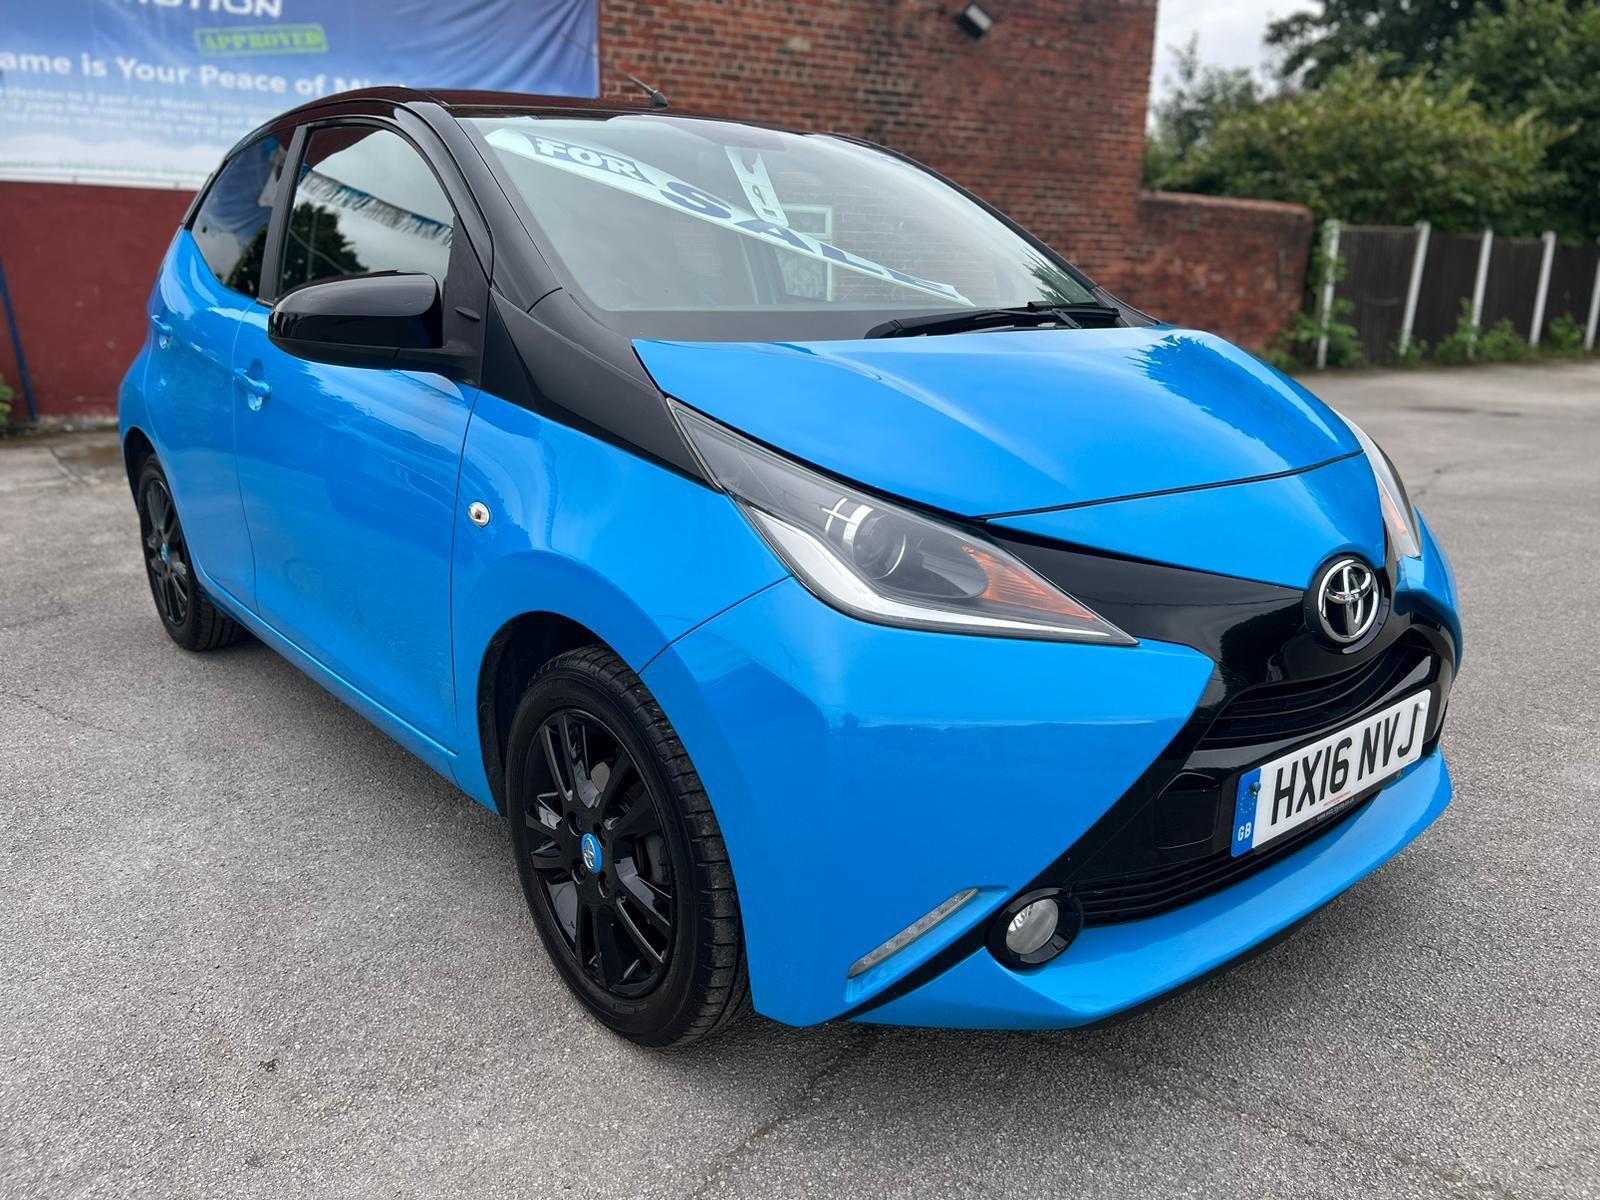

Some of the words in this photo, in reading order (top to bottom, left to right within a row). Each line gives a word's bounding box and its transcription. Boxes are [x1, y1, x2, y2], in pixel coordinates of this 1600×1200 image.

[203, 31, 323, 50] APPROVED
[80, 53, 107, 78] is
[116, 56, 190, 85] Your
[200, 64, 287, 94] Peace
[296, 73, 327, 97] of
[534, 136, 644, 182] FOR
[1270, 736, 1353, 827] HX16
[1357, 703, 1420, 782] NVJ
[1237, 821, 1252, 842] GB
